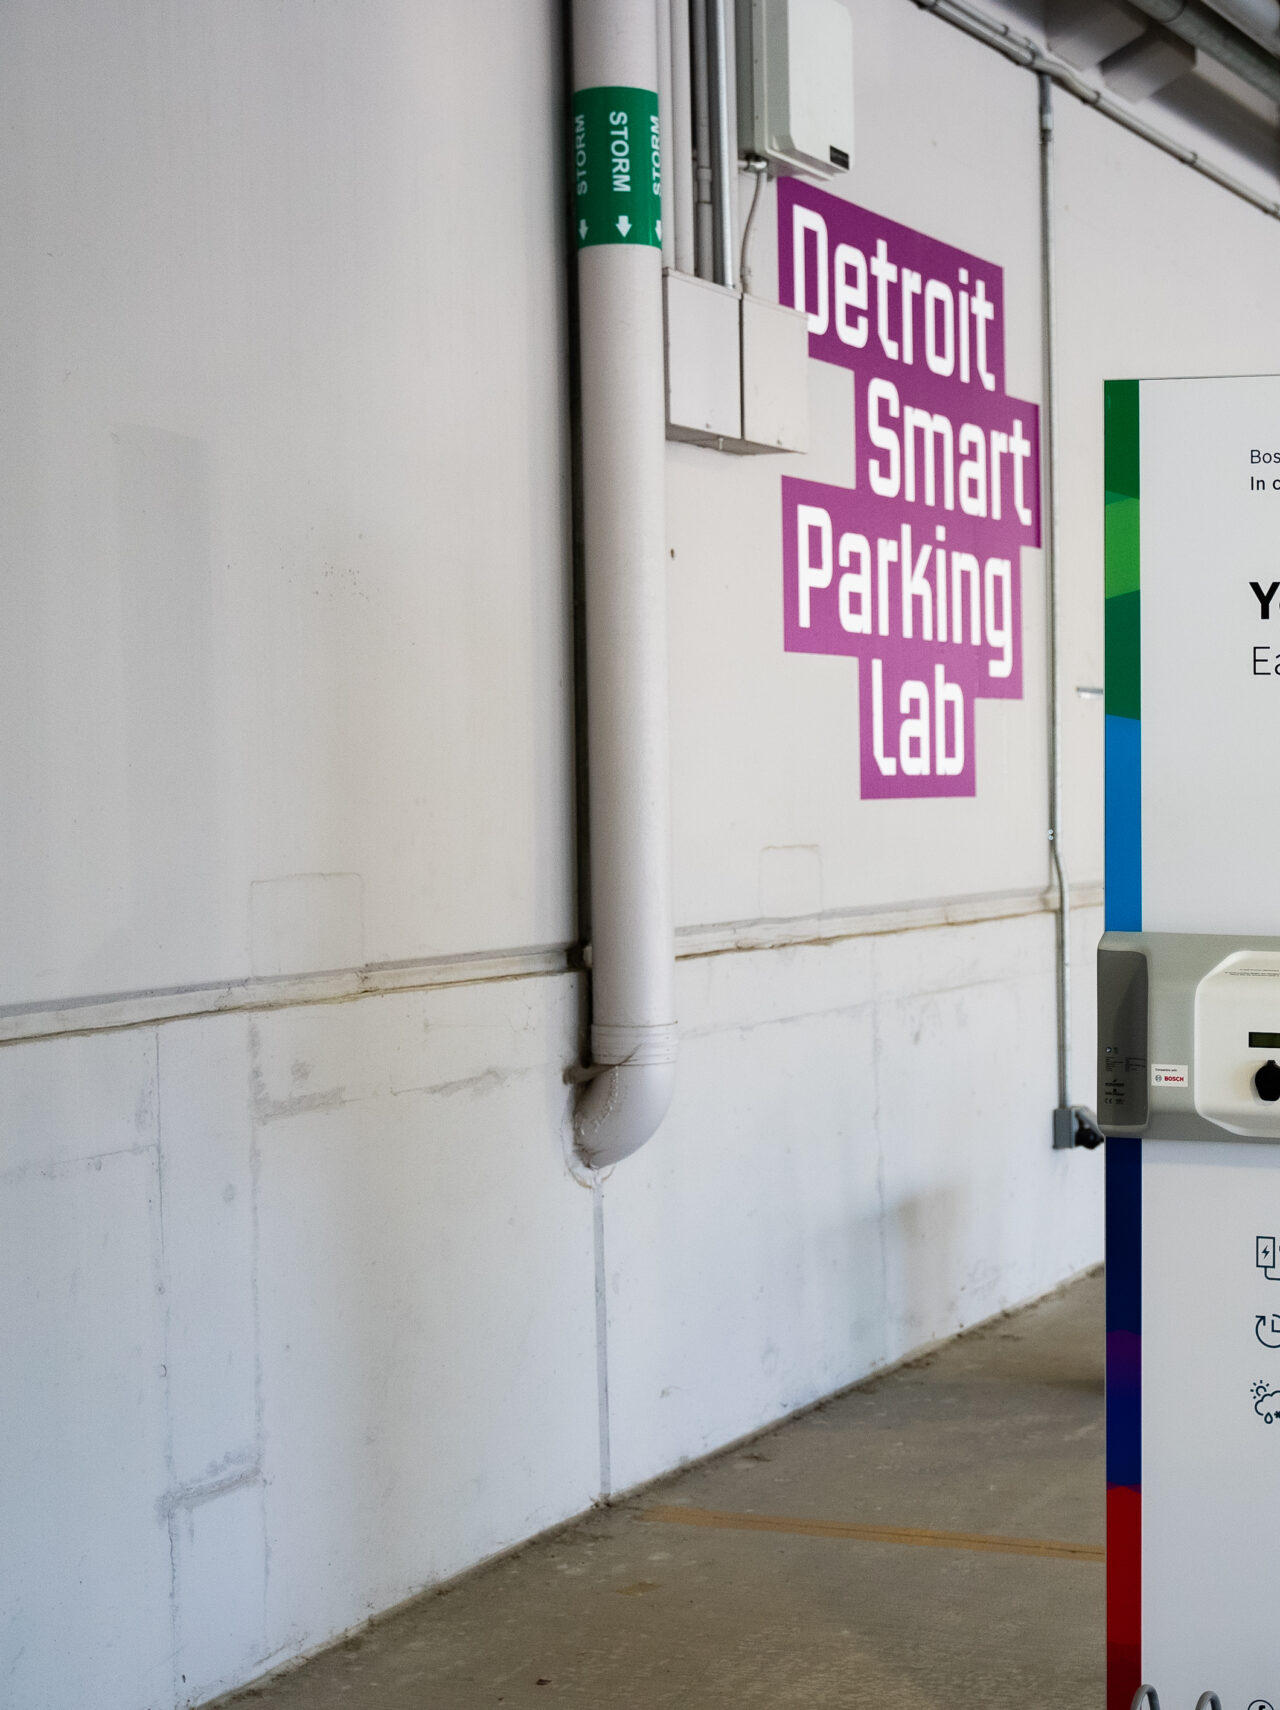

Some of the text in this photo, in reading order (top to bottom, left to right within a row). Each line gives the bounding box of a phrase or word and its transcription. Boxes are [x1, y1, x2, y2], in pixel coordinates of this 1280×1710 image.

[576, 115, 588, 197] STORM
[610, 111, 632, 193] STORM
[793, 203, 996, 393] Detroit
[867, 376, 1032, 527] Smart
[1251, 477, 1265, 490] In
[797, 503, 1014, 679] Parking
[871, 657, 966, 777] Lab
